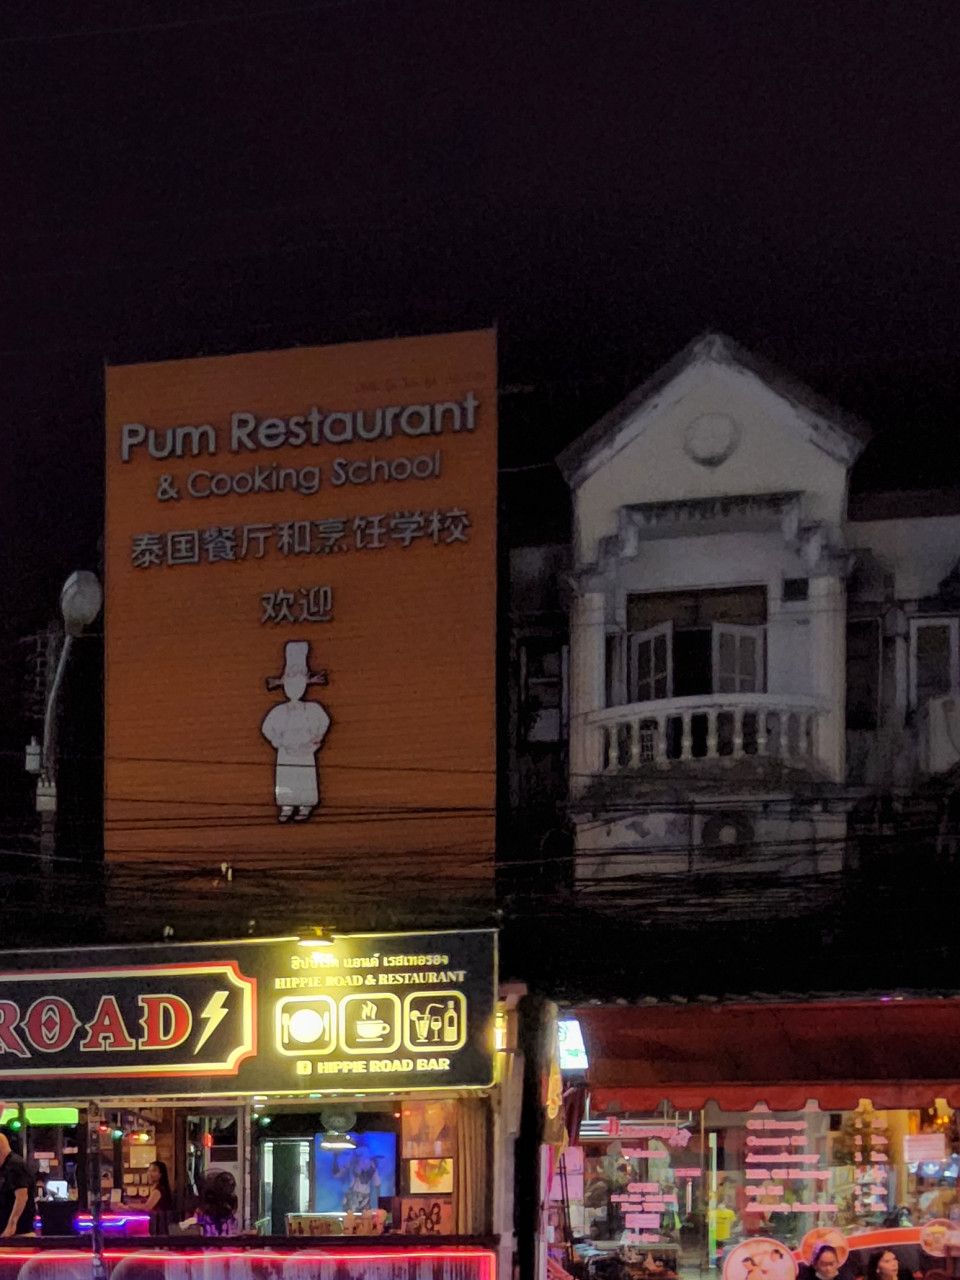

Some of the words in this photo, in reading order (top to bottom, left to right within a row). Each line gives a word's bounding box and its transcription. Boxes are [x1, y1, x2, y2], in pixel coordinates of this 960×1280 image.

[121, 423, 215, 460] Pum
[230, 392, 479, 452] Restaurant
[157, 475, 178, 500] &
[187, 463, 320, 499] Cooking
[332, 451, 440, 484] School
[131, 508, 471, 567] 泰国餐厅和烹饪学校
[260, 586, 333, 624] 欢迎
[275, 976, 322, 989] HIPPIE
[326, 974, 363, 987] ROAD
[365, 974, 377, 986] &
[378, 970, 467, 986] RESTAURANT
[318, 1060, 367, 1074] HIPPIE
[369, 1059, 414, 1072] ROAD
[417, 1058, 451, 1071] BAR
